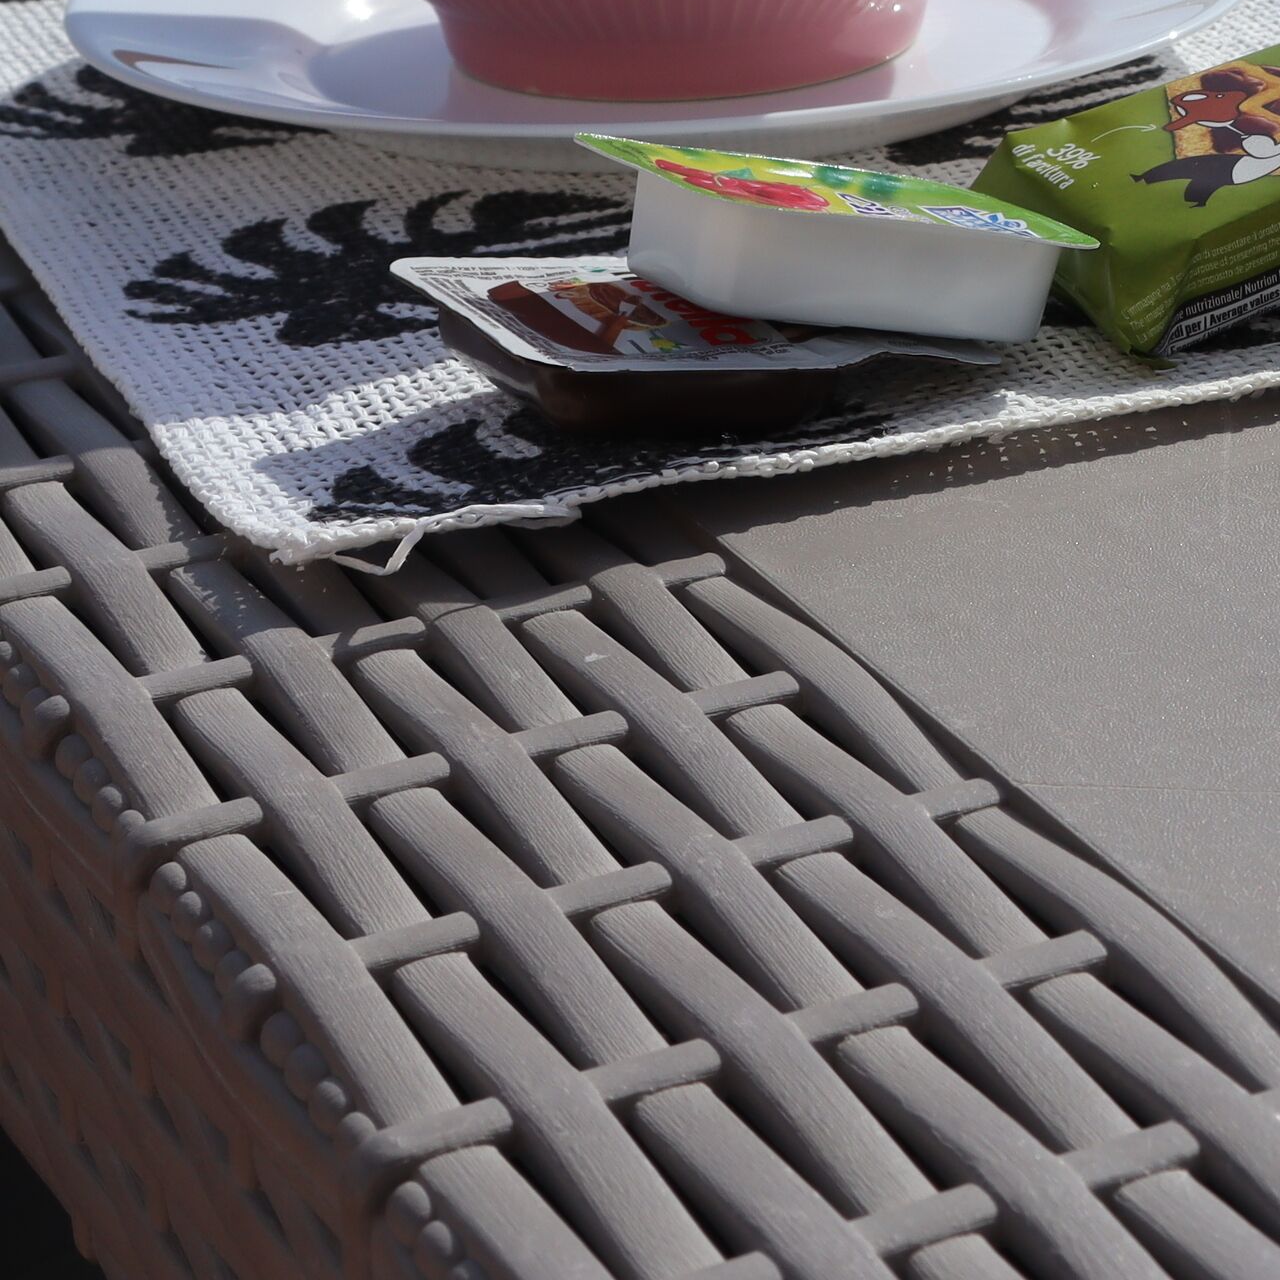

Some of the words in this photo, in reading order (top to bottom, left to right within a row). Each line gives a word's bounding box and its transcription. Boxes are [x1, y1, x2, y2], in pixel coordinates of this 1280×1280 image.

[1012, 144, 1036, 157] di
[1046, 143, 1101, 169] 39%
[1245, 274, 1277, 294] Nutrion
[1186, 321, 1201, 335] per
[1210, 303, 1248, 325] Average
[1249, 289, 1280, 307] values
